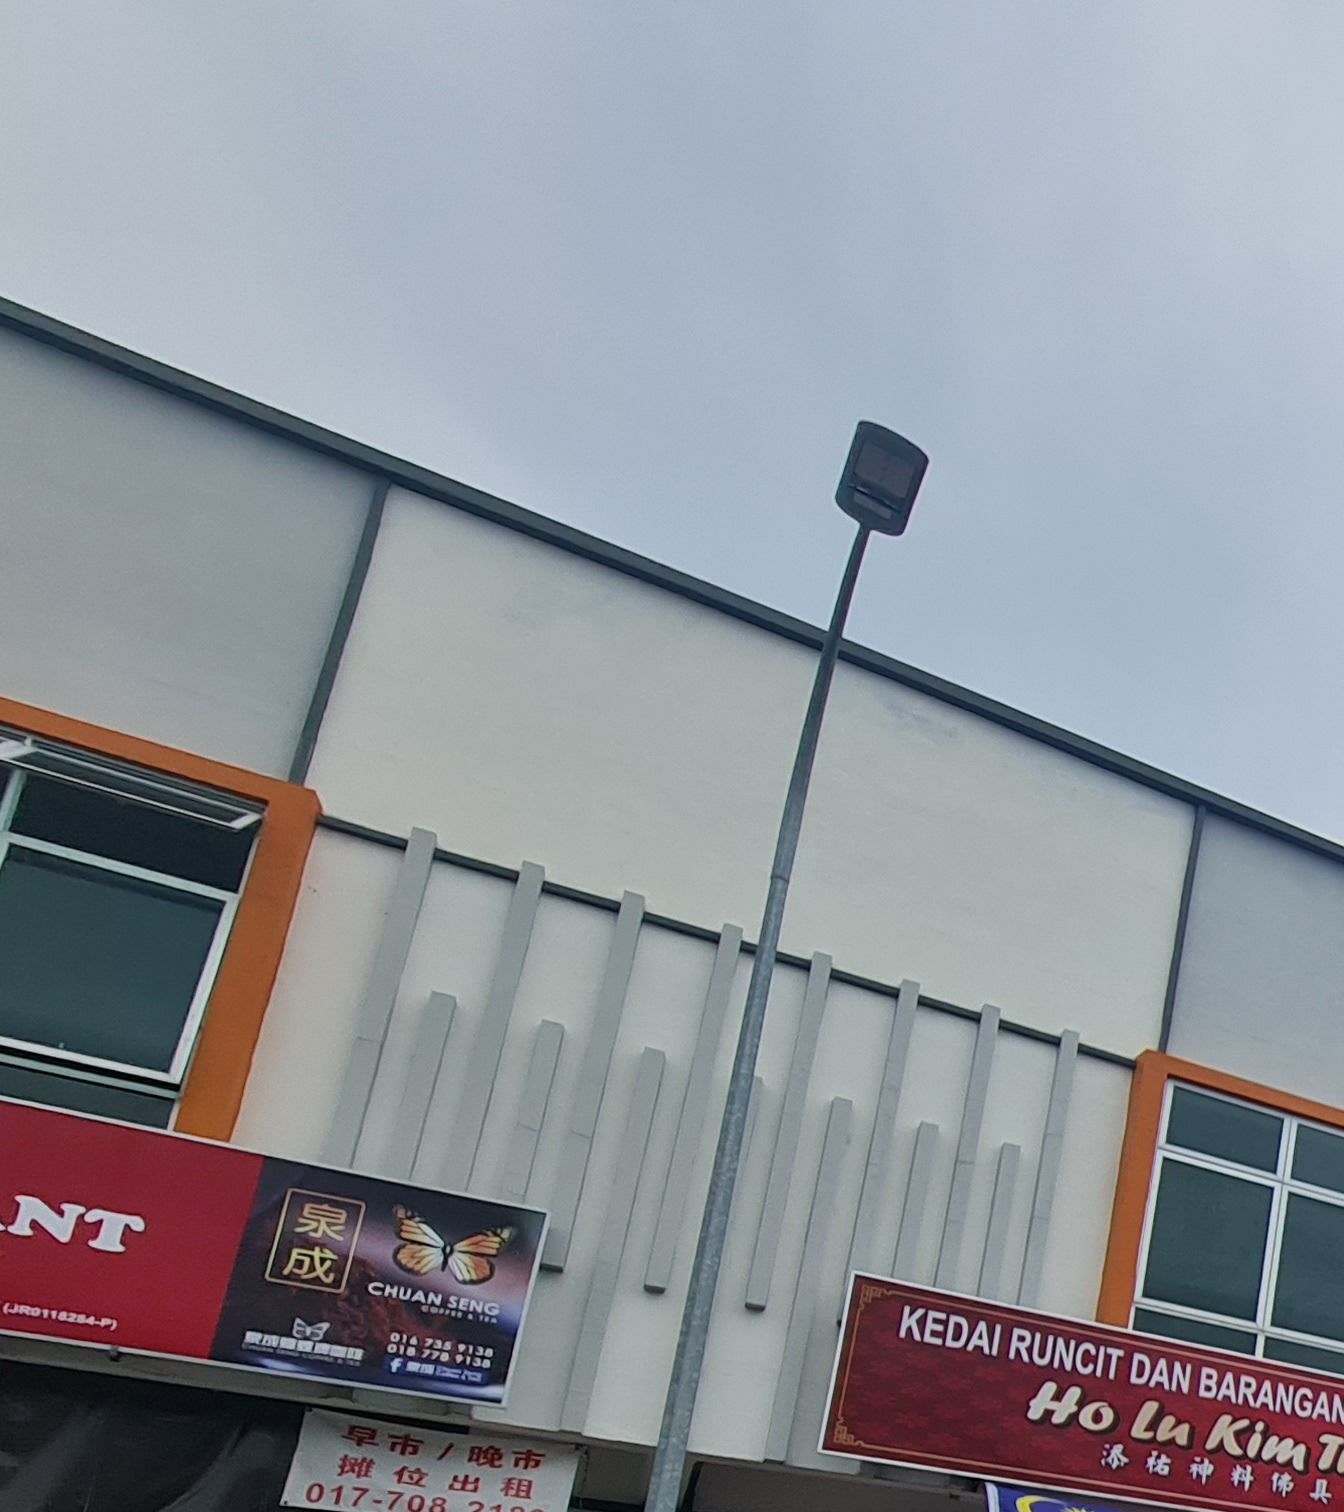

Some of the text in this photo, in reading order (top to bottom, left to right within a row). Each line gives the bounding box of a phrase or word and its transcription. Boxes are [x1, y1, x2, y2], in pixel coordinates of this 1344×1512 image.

[0, 1195, 146, 1253] NT
[282, 1203, 347, 1284] 泉成
[367, 1281, 500, 1316] CHUAN SENG
[899, 1305, 1002, 1356] KEDAI
[1008, 1327, 1124, 1380] RUNCIT
[1129, 1352, 1192, 1395] DAN
[1027, 1381, 1116, 1433] Ho
[1130, 1401, 1191, 1446] Lu
[1205, 1413, 1306, 1472] Kim
